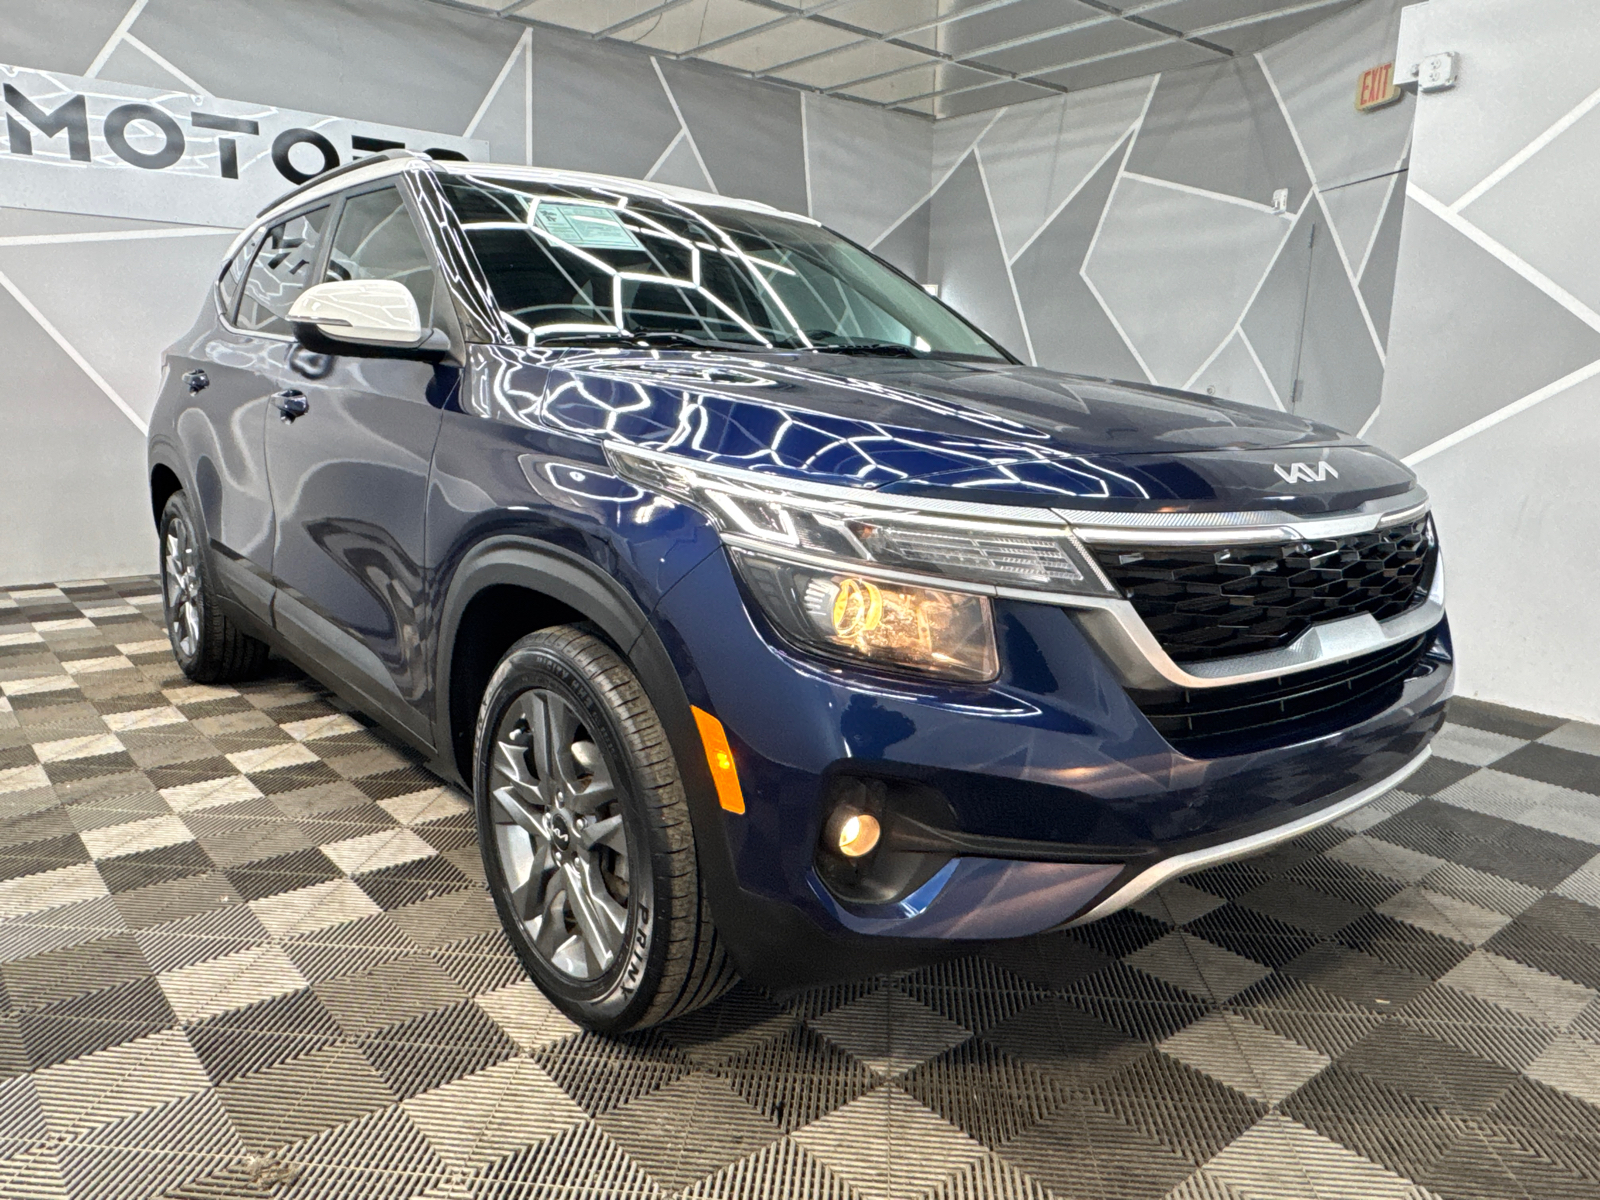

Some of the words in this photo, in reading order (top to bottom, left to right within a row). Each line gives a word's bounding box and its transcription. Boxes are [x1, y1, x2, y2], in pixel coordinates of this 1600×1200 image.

[3, 83, 470, 185] MOTO
[1360, 62, 1392, 106] EXIT
[619, 901, 650, 1001] PRINX
